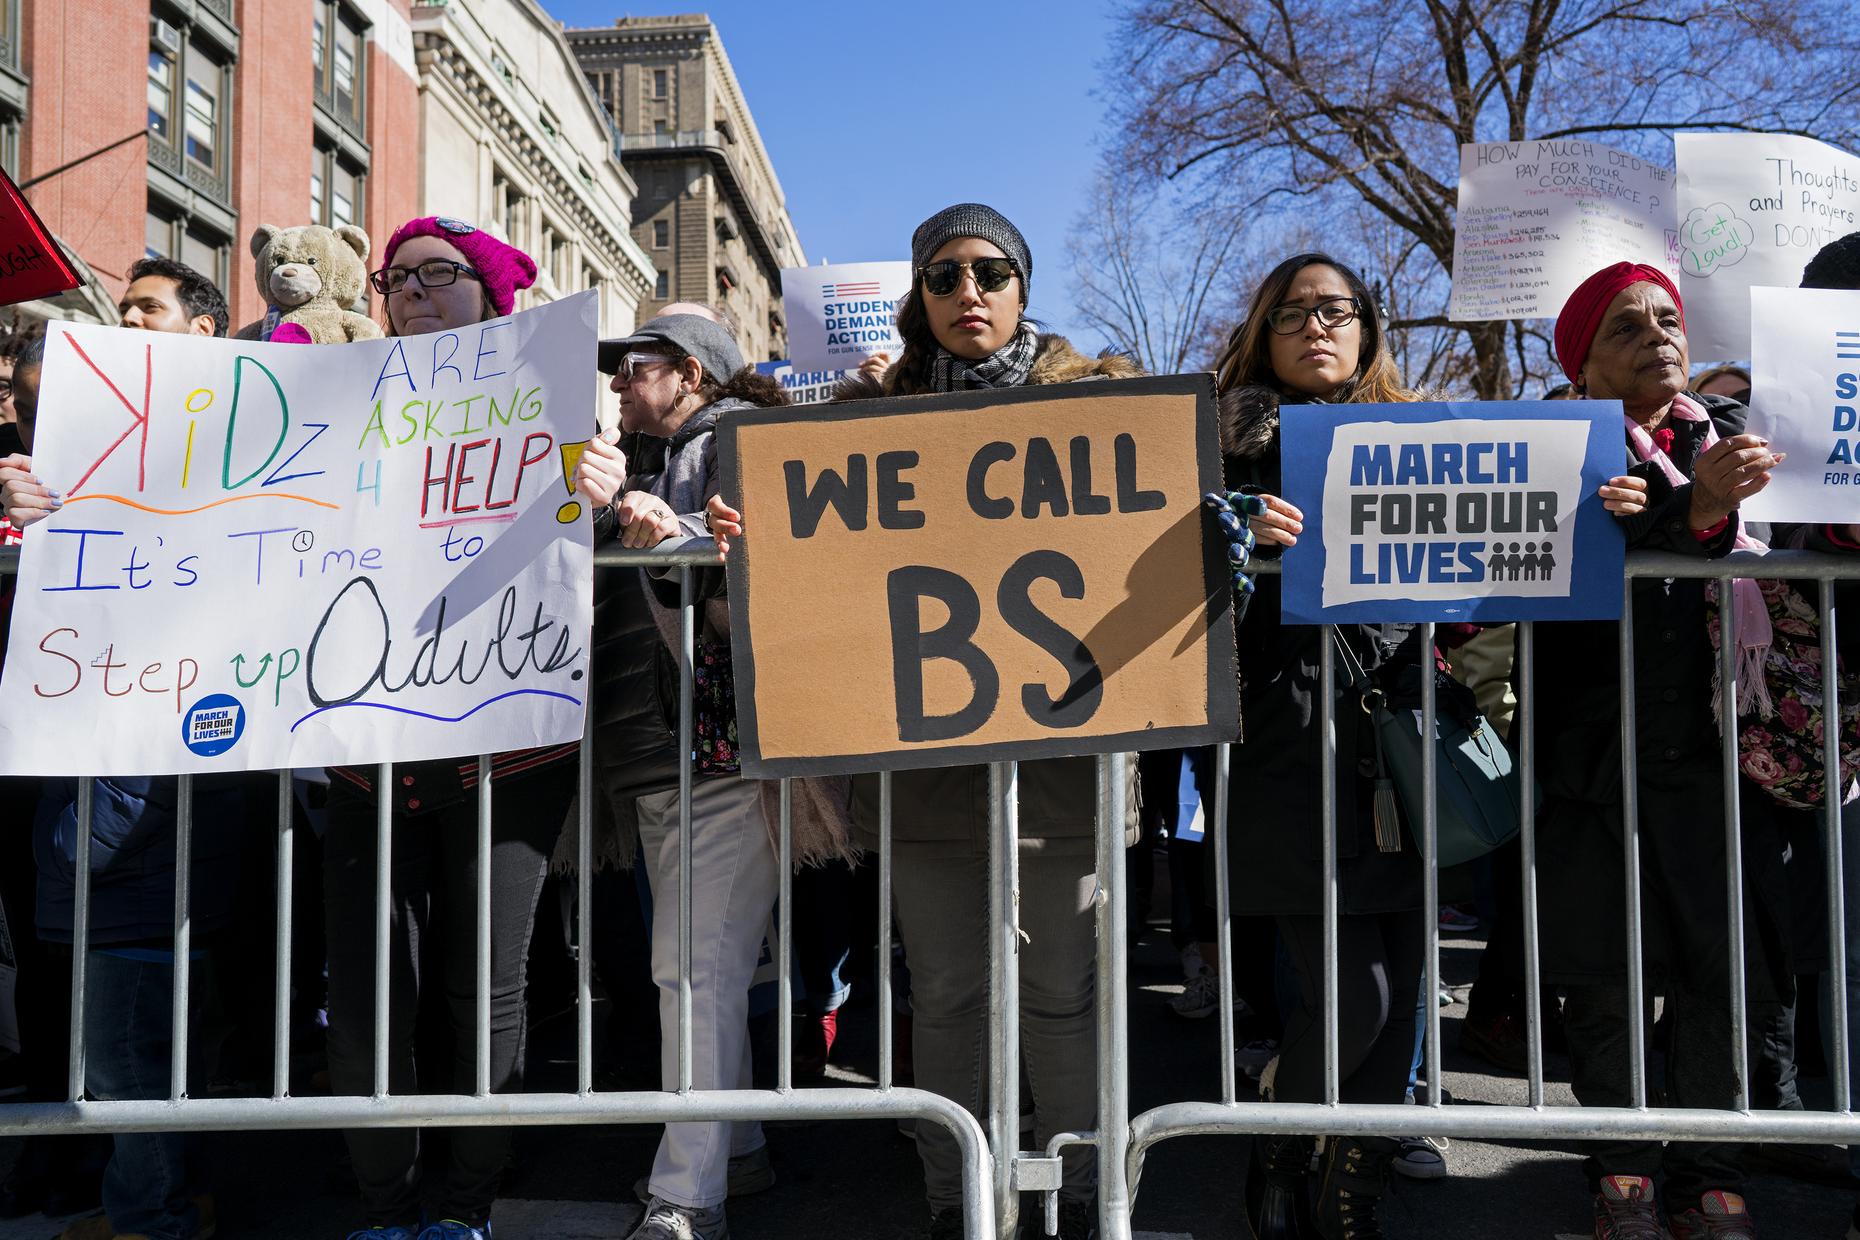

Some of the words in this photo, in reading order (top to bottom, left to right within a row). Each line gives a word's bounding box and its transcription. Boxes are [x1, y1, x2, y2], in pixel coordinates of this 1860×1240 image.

[1477, 143, 1521, 167] HOW
[1537, 141, 1595, 161] MUCH
[1608, 150, 1642, 171] DID
[1646, 164, 1668, 182] THE
[1515, 163, 1540, 179] PAY
[1551, 161, 1580, 175] FOR
[1765, 158, 1859, 200] Thoughts
[1539, 175, 1641, 204] CONSCIENCE
[1749, 189, 1784, 212] and
[1802, 190, 1855, 227] Prayers
[1465, 205, 1510, 216] Alabama
[1690, 215, 1728, 246] Get
[1692, 227, 1744, 272] Loud!
[1775, 223, 1835, 248] DON'T
[0, 243, 48, 279] UGH
[827, 329, 892, 345] ACTION
[841, 346, 854, 354] GUN
[370, 321, 512, 402] ARE
[793, 386, 817, 403] OR
[358, 386, 543, 450] ASKING
[1350, 442, 1529, 486] MARCH
[1824, 472, 1849, 485] FOR
[356, 460, 383, 507] 4
[783, 450, 926, 539] WE
[966, 433, 1167, 519] CALL
[1350, 493, 1448, 536] FOR
[1456, 491, 1559, 534] OUR
[42, 528, 199, 592] It's
[227, 526, 383, 586] Time
[439, 526, 484, 562] to
[1350, 541, 1487, 585] LIVES
[887, 549, 1104, 742] BS
[34, 627, 199, 714] Step
[230, 646, 302, 706] up
[194, 721, 213, 731] FOR
[214, 718, 233, 729] OUR
[194, 729, 220, 740] LIVES
[196, 710, 229, 722] MARCH
